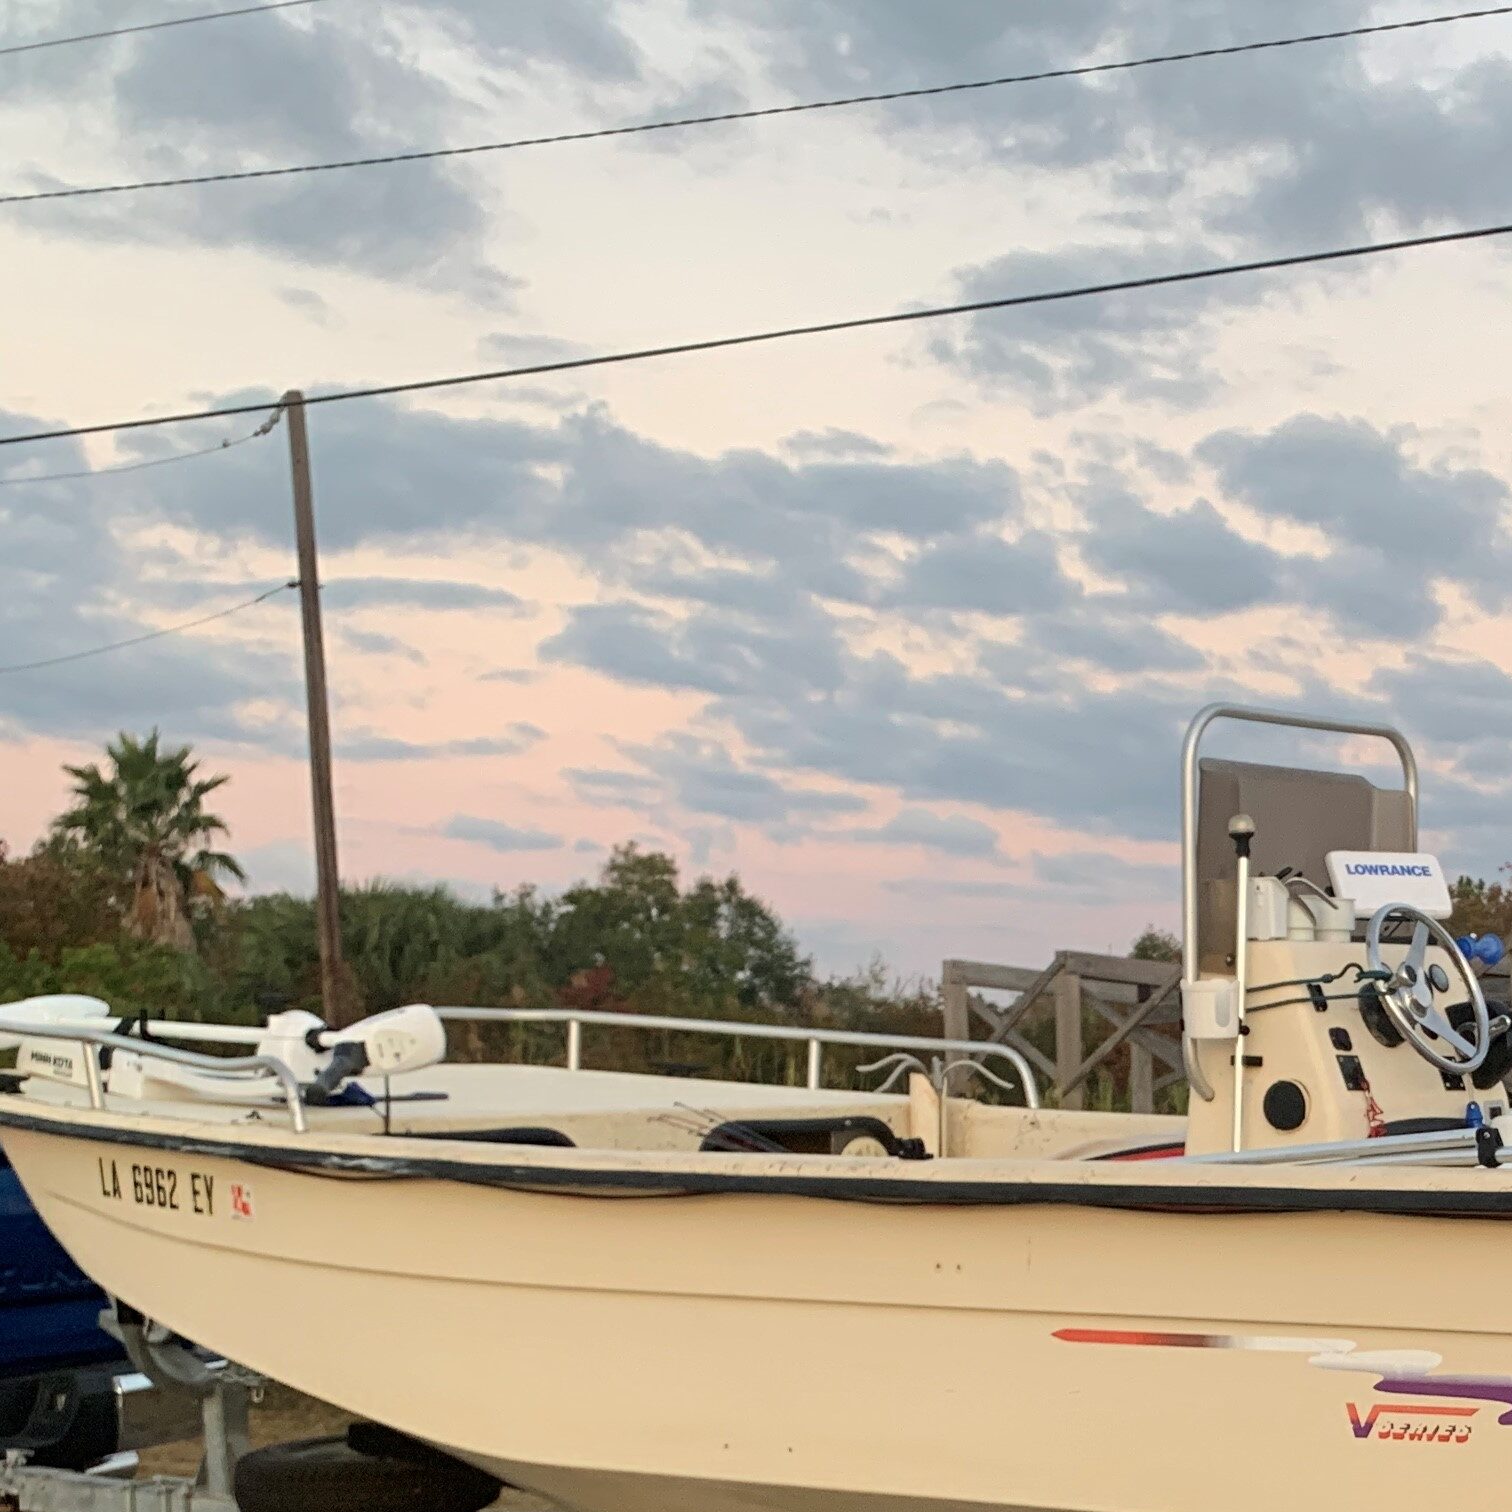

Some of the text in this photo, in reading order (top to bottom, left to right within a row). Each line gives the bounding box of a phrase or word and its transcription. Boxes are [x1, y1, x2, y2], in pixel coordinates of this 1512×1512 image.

[1344, 863, 1432, 877] LOWRANCE
[98, 1156, 122, 1200] LA
[131, 1163, 179, 1210] 6962
[190, 1172, 214, 1216] EY
[1378, 1421, 1472, 1443] SERIES
